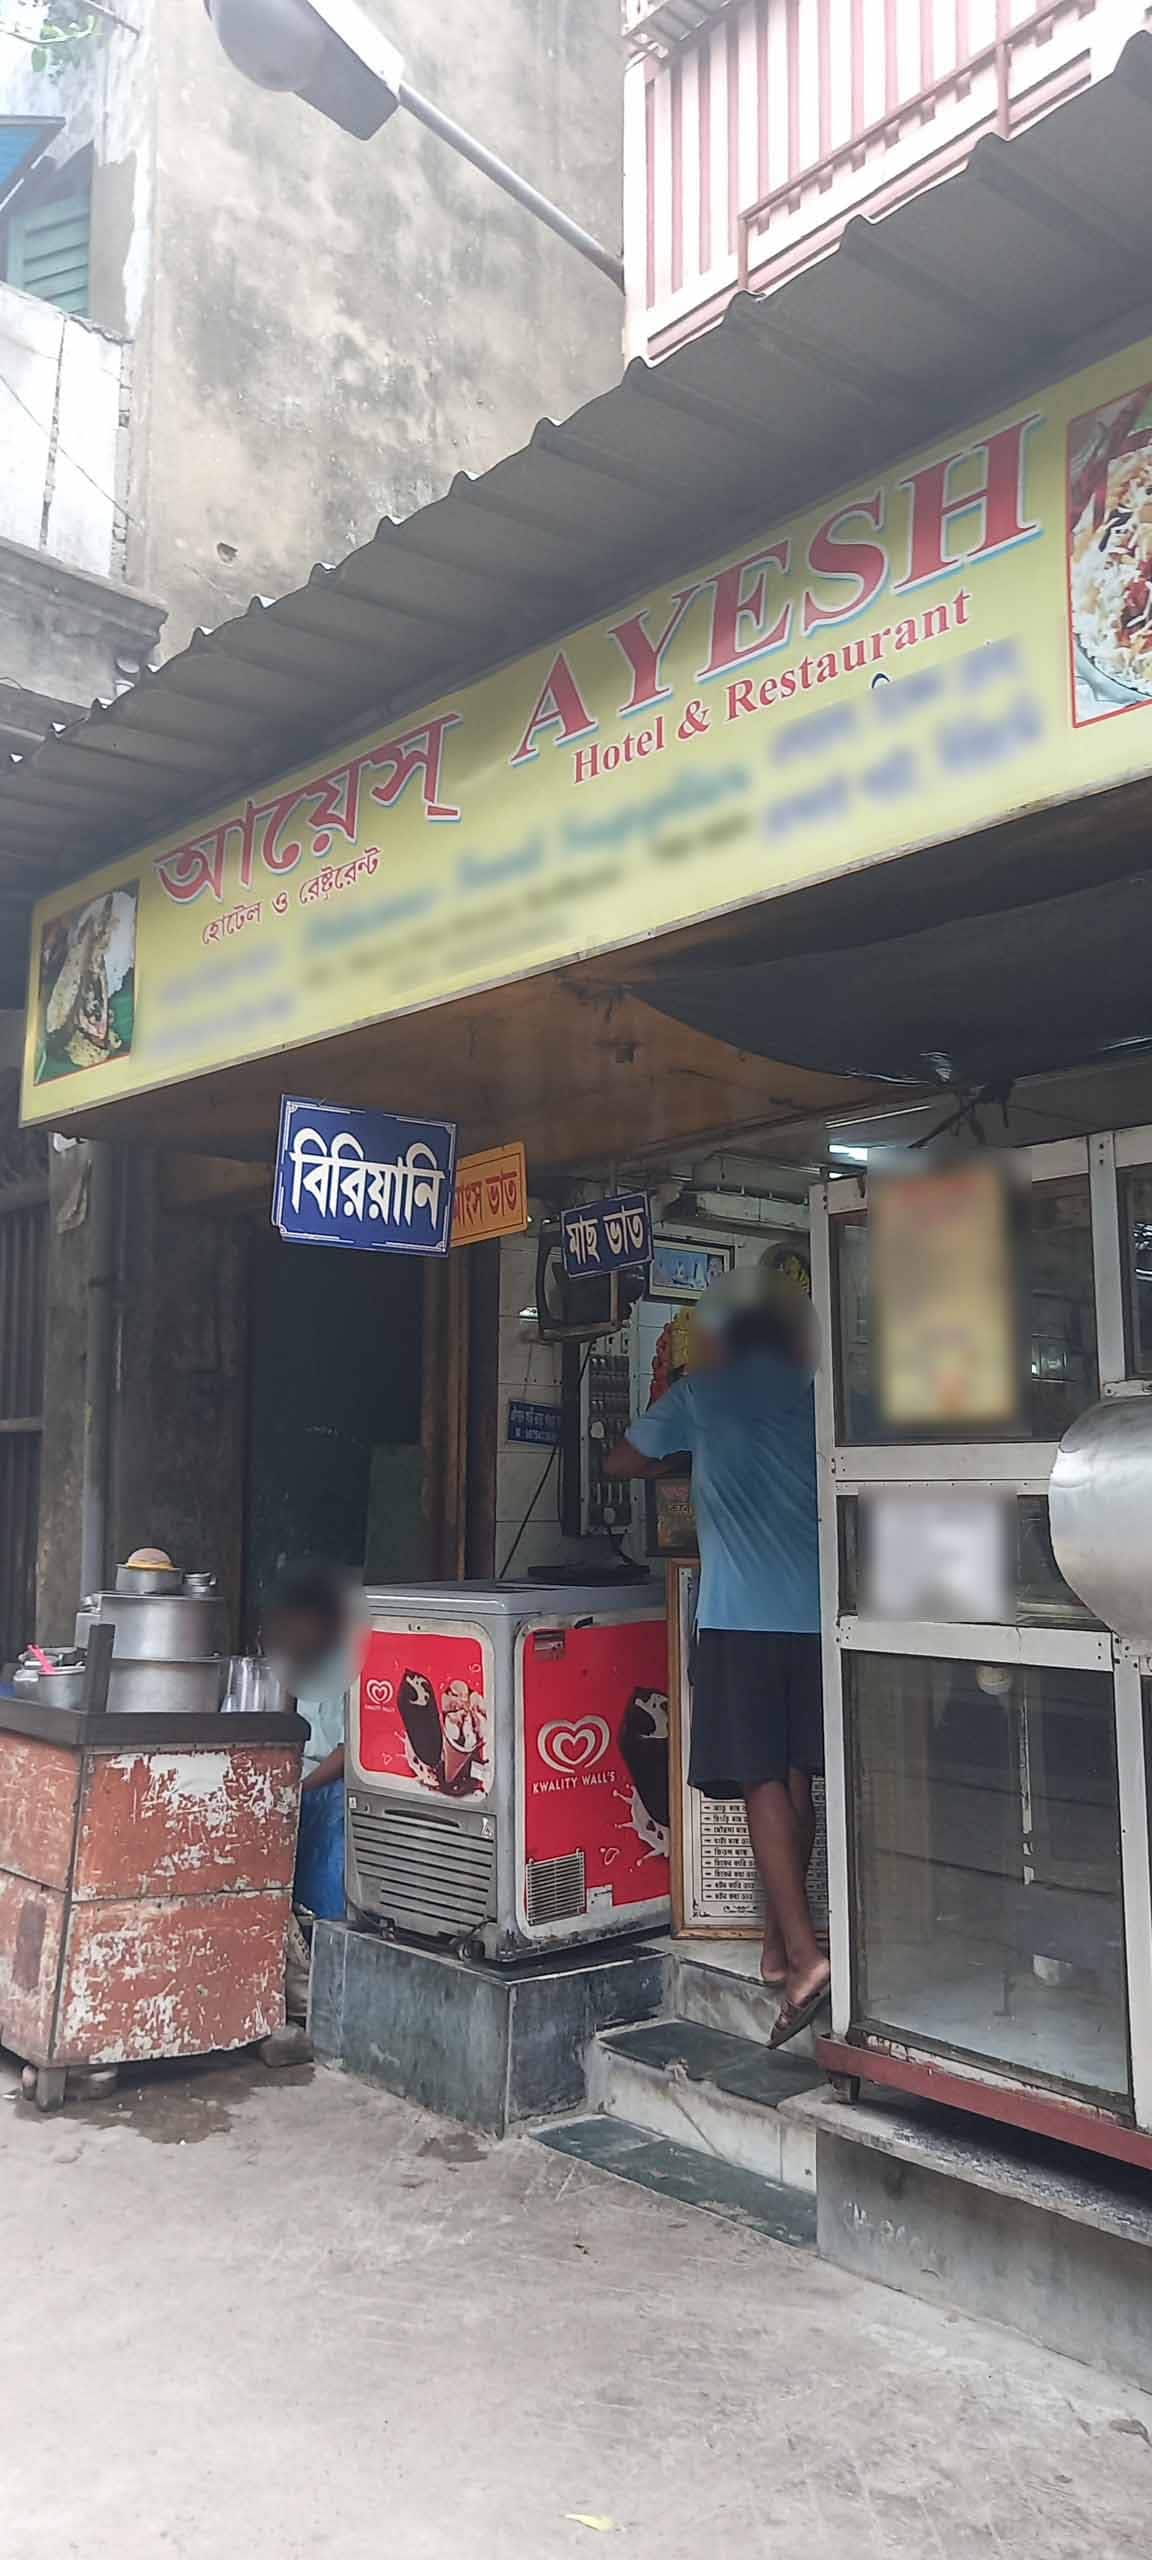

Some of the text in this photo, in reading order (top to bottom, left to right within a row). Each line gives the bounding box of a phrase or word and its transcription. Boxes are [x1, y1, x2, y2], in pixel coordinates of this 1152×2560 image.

[508, 411, 1043, 768] AYESH
[573, 716, 665, 786] Hotel
[677, 699, 711, 741] &
[725, 589, 972, 723] Restaurant
[202, 902, 262, 945] হোটেল
[271, 891, 289, 914] ও
[288, 1127, 446, 1232] বিরিয়ানি
[485, 1169, 518, 1216] ভাত
[565, 1204, 645, 1265] মাছ ভাত
[532, 1771, 616, 1794] KWALITY WALL'S
